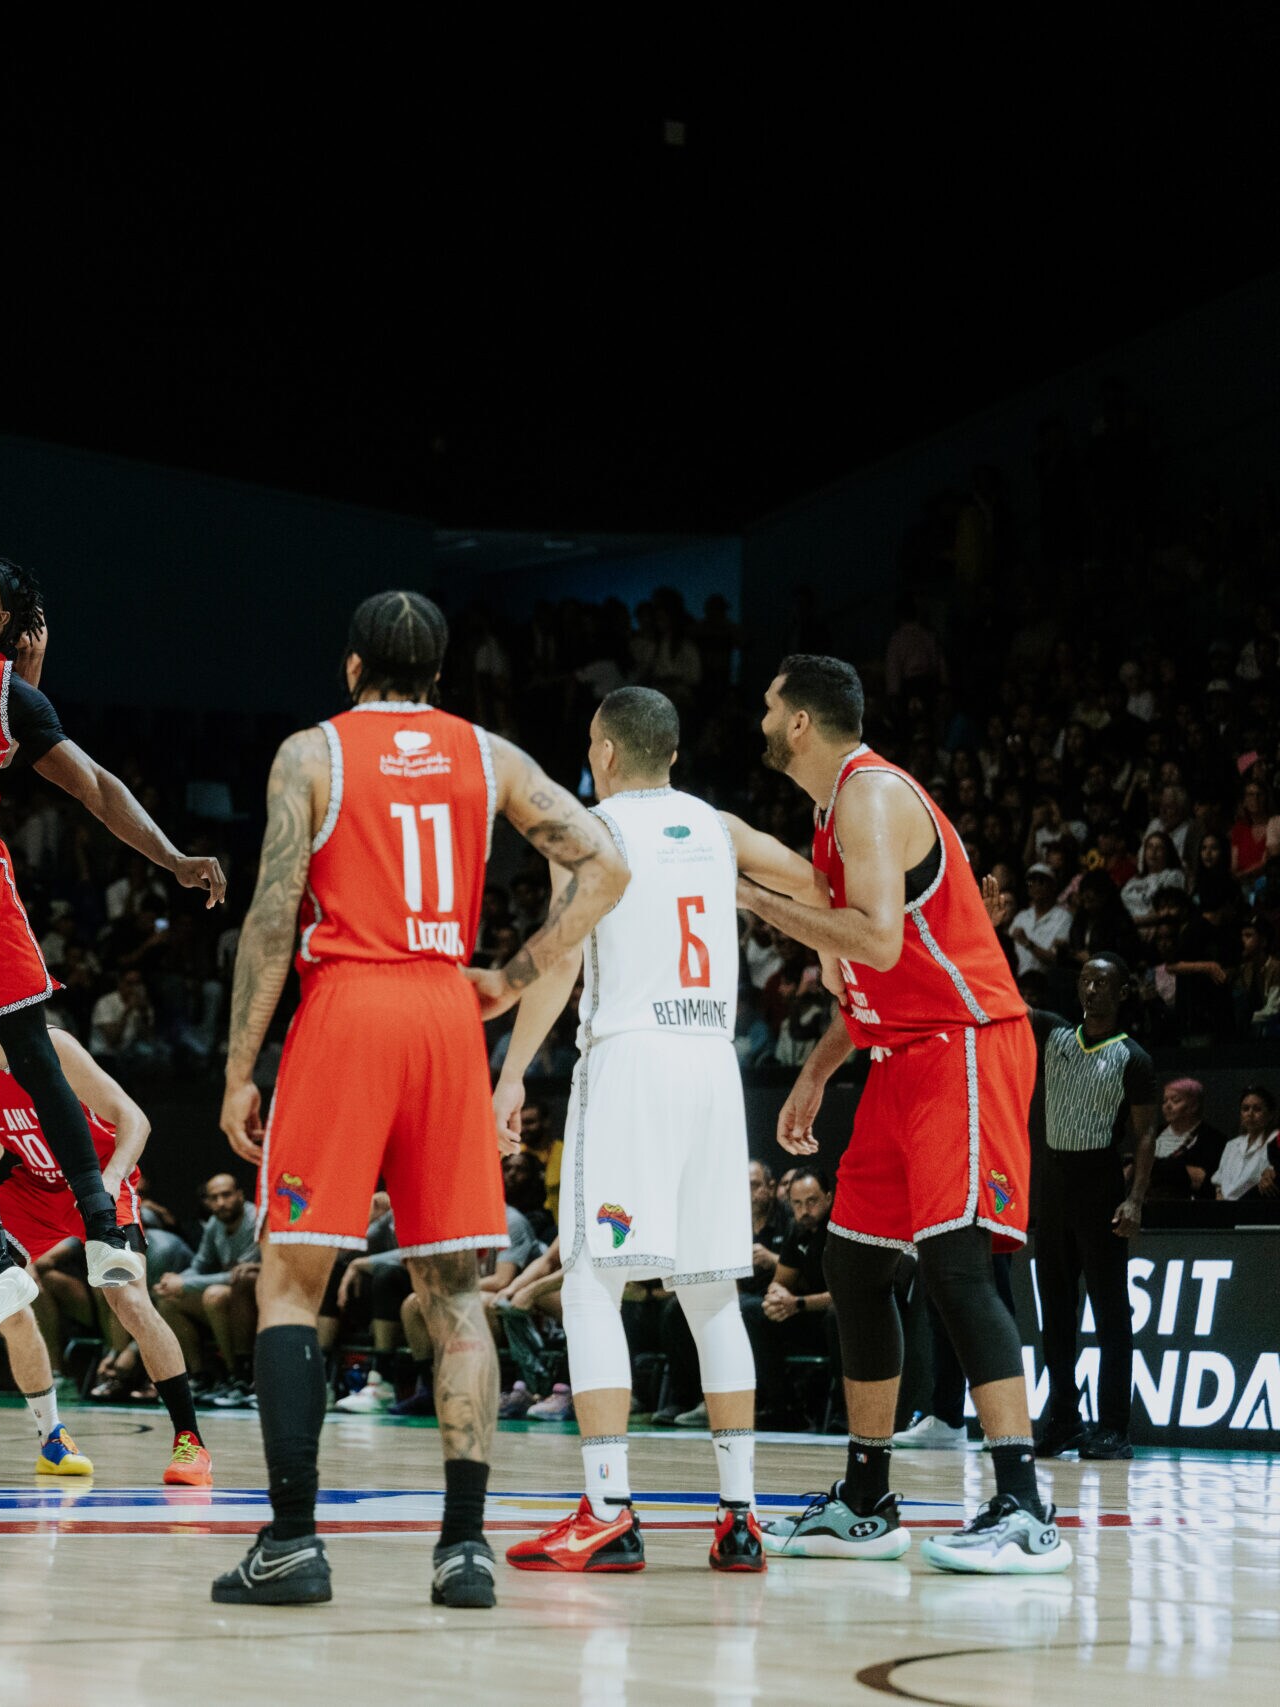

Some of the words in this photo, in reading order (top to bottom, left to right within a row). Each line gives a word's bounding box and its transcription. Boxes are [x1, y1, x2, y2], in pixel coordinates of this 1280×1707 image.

[390, 802, 455, 914] 11
[676, 895, 711, 989] 6
[6, 1133, 57, 1169] 10
[1030, 1257, 1234, 1336] SIT
